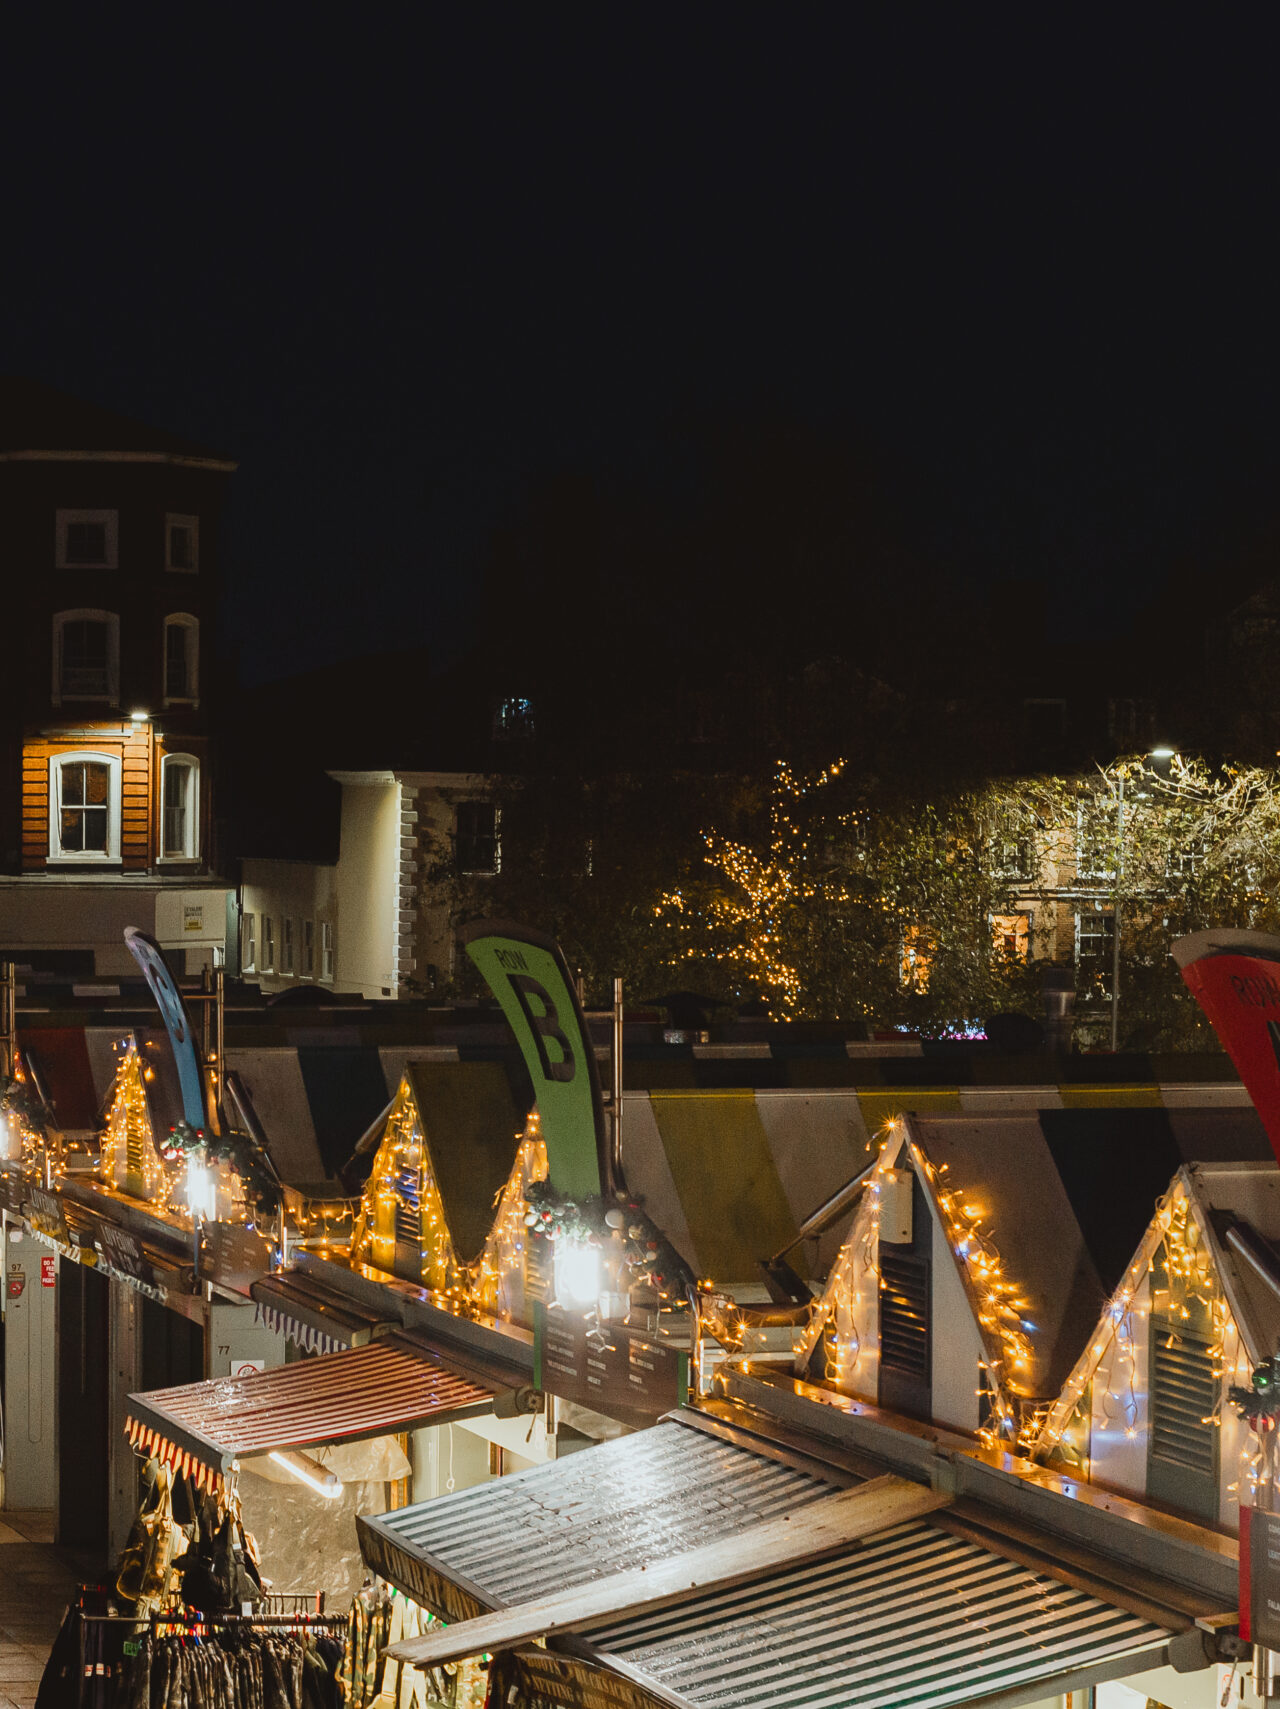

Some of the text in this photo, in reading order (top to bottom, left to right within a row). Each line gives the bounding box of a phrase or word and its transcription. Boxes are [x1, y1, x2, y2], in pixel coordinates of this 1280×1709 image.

[494, 948, 529, 971] ROW
[506, 973, 576, 1083] B
[11, 1263, 22, 1272] 97
[217, 1345, 230, 1355] 77
